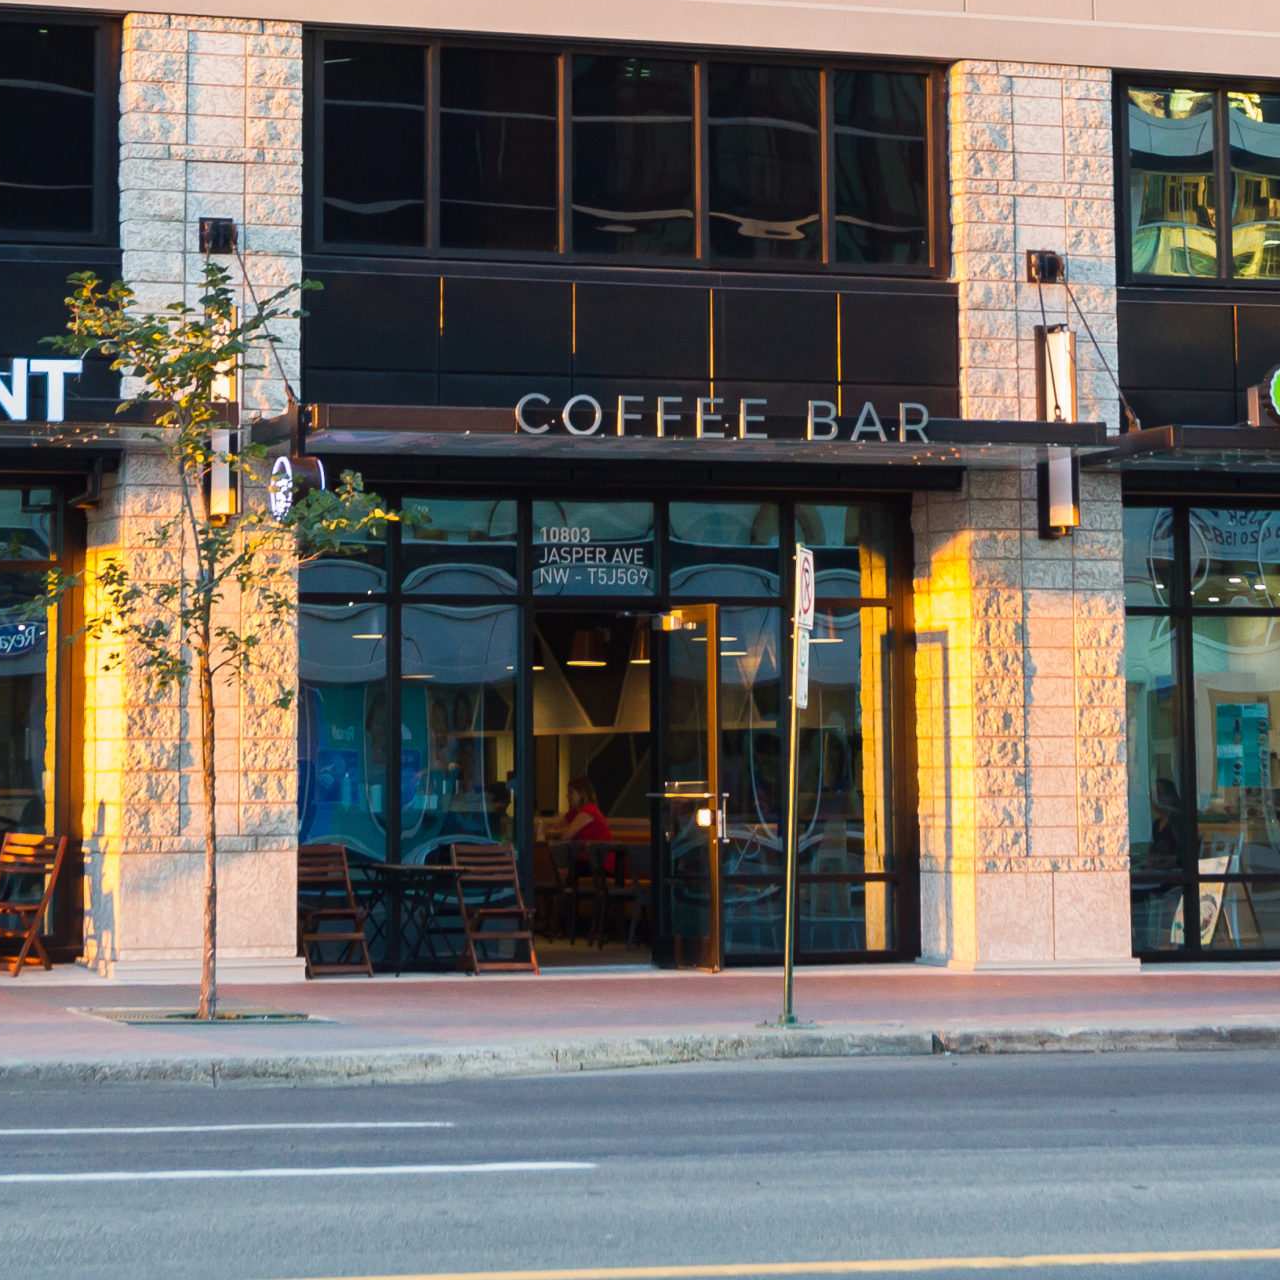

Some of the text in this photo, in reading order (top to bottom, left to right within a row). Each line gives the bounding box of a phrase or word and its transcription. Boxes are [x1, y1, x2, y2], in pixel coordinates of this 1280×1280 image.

[515, 393, 929, 444] COFFEE BAR
[540, 526, 591, 543] 10803
[539, 547, 644, 565] JASPER AVE
[540, 568, 570, 584] NW
[587, 568, 648, 585] T5J5G9
